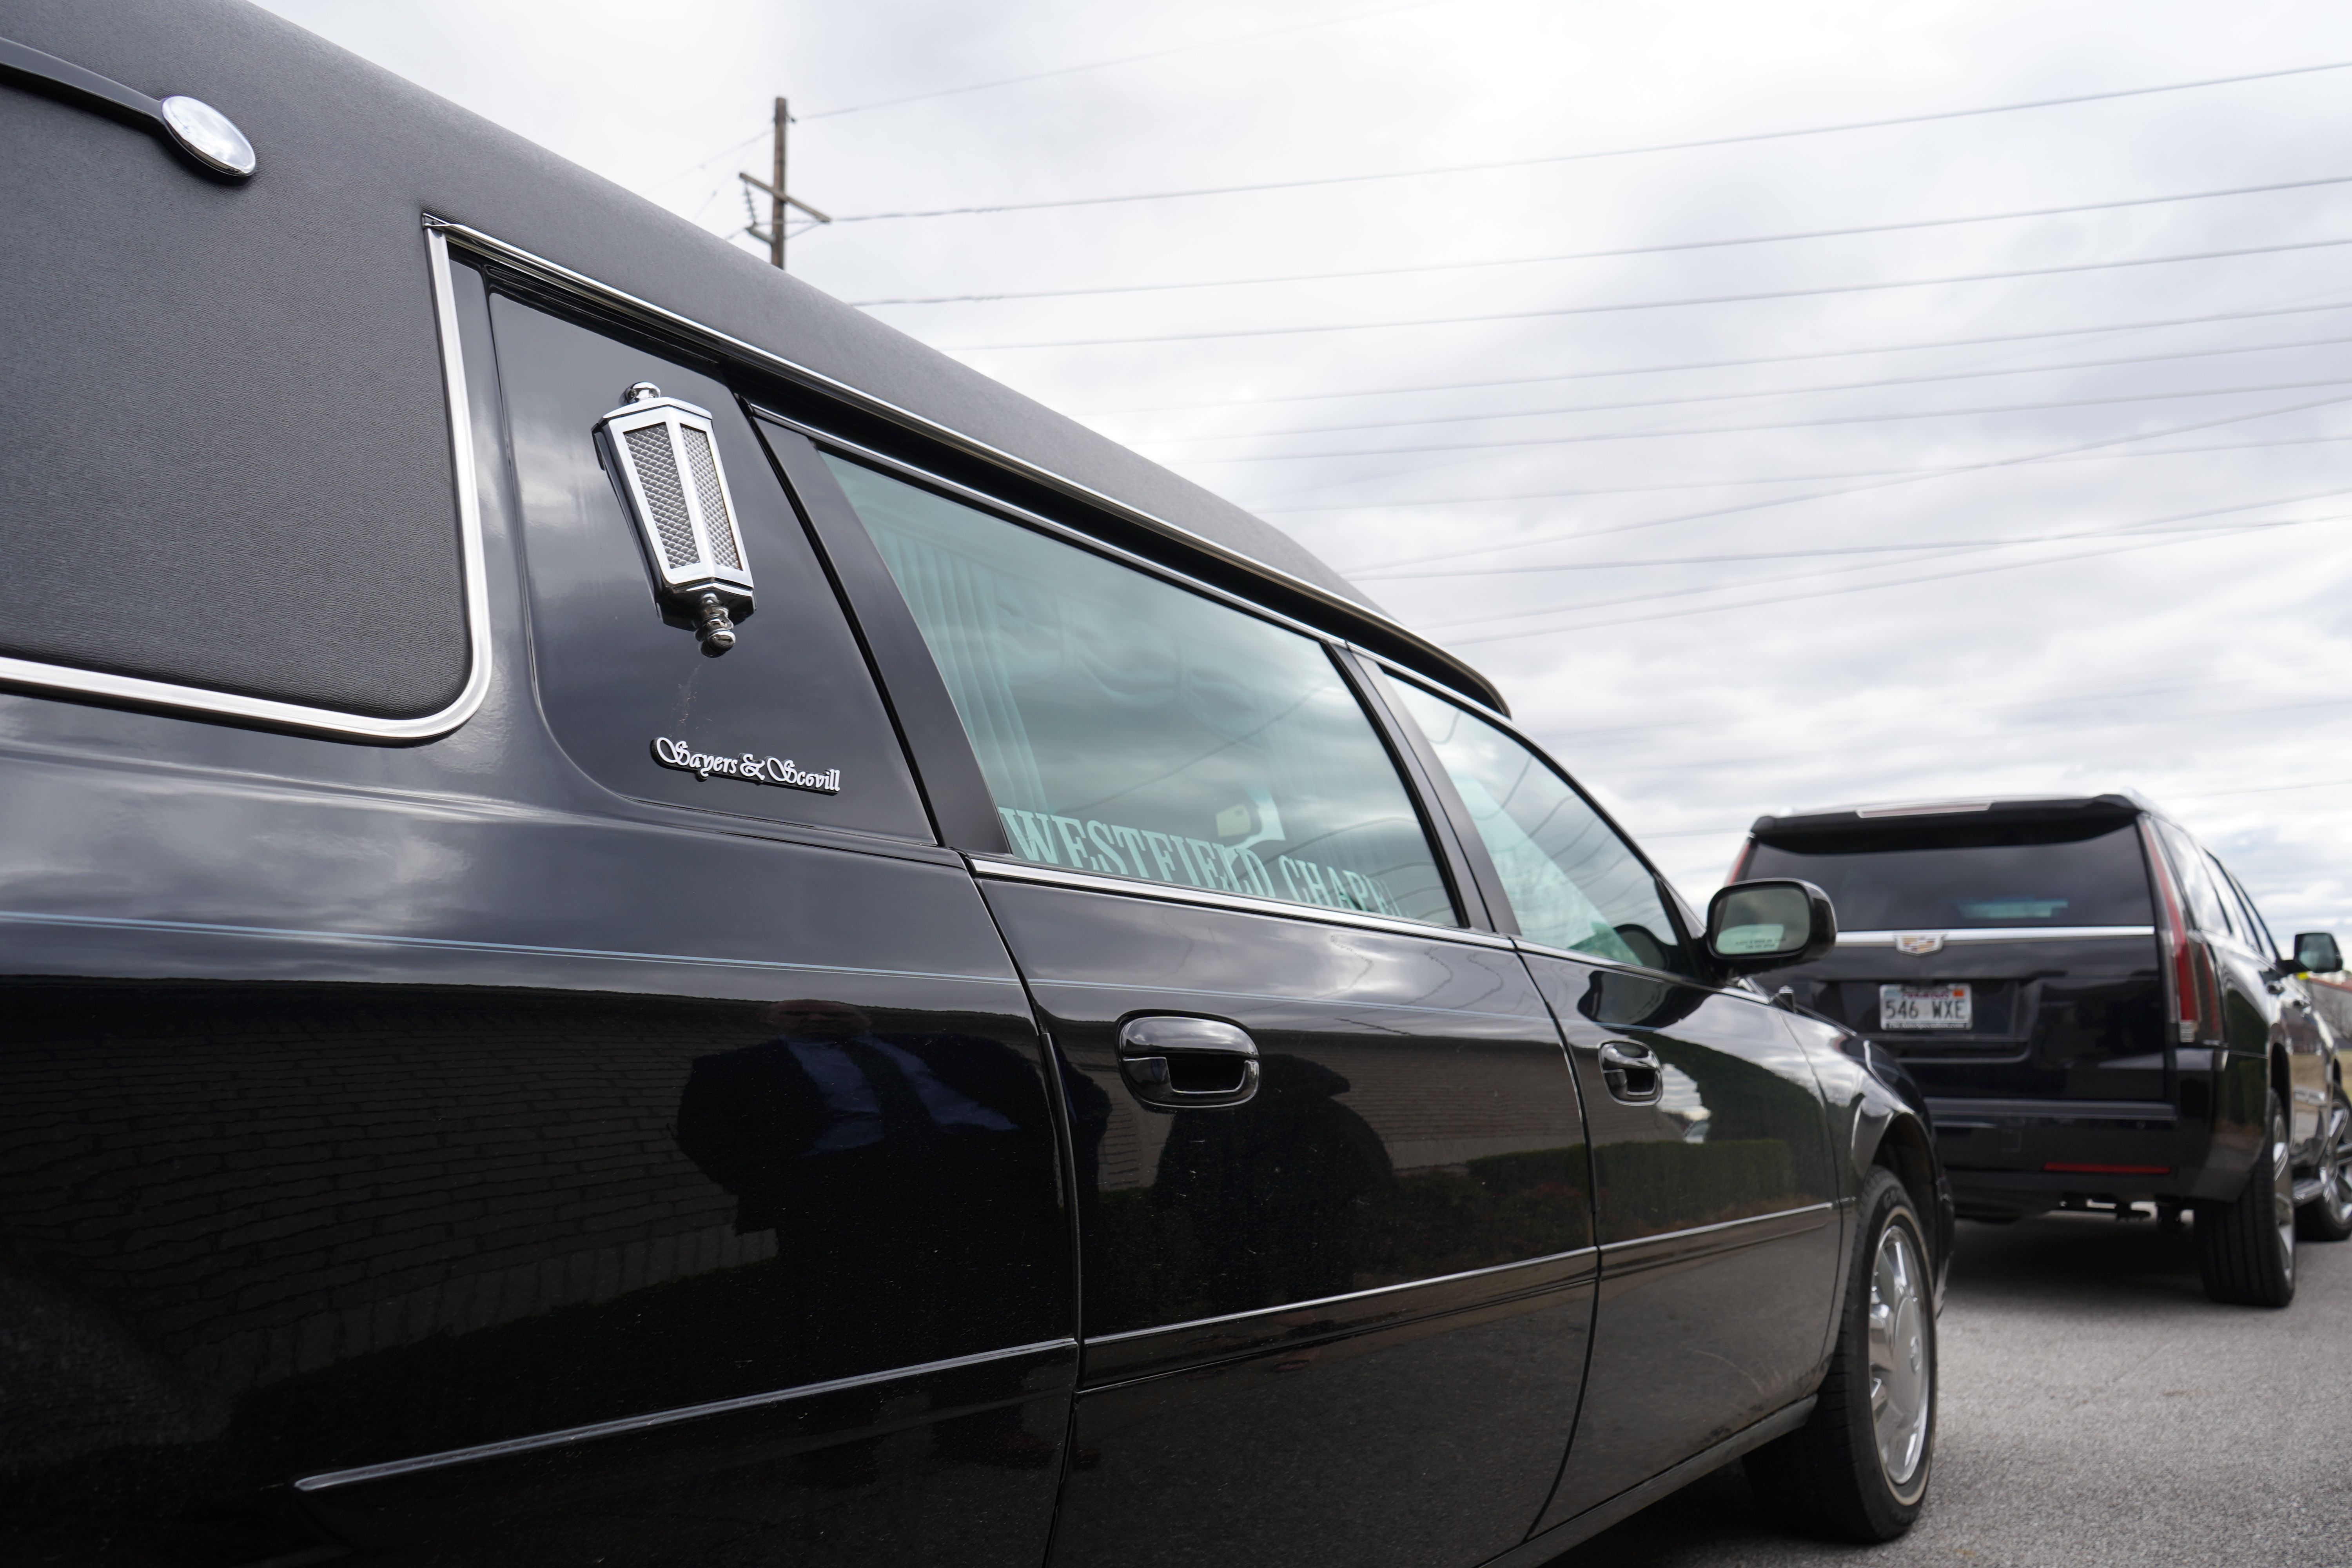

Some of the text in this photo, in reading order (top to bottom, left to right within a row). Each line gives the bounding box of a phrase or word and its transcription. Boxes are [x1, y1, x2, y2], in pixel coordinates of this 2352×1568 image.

[655, 737, 840, 792] Sayers & Scovill
[998, 806, 1276, 898] WESTFIELD
[1885, 999, 1965, 1019] 546 WXE
